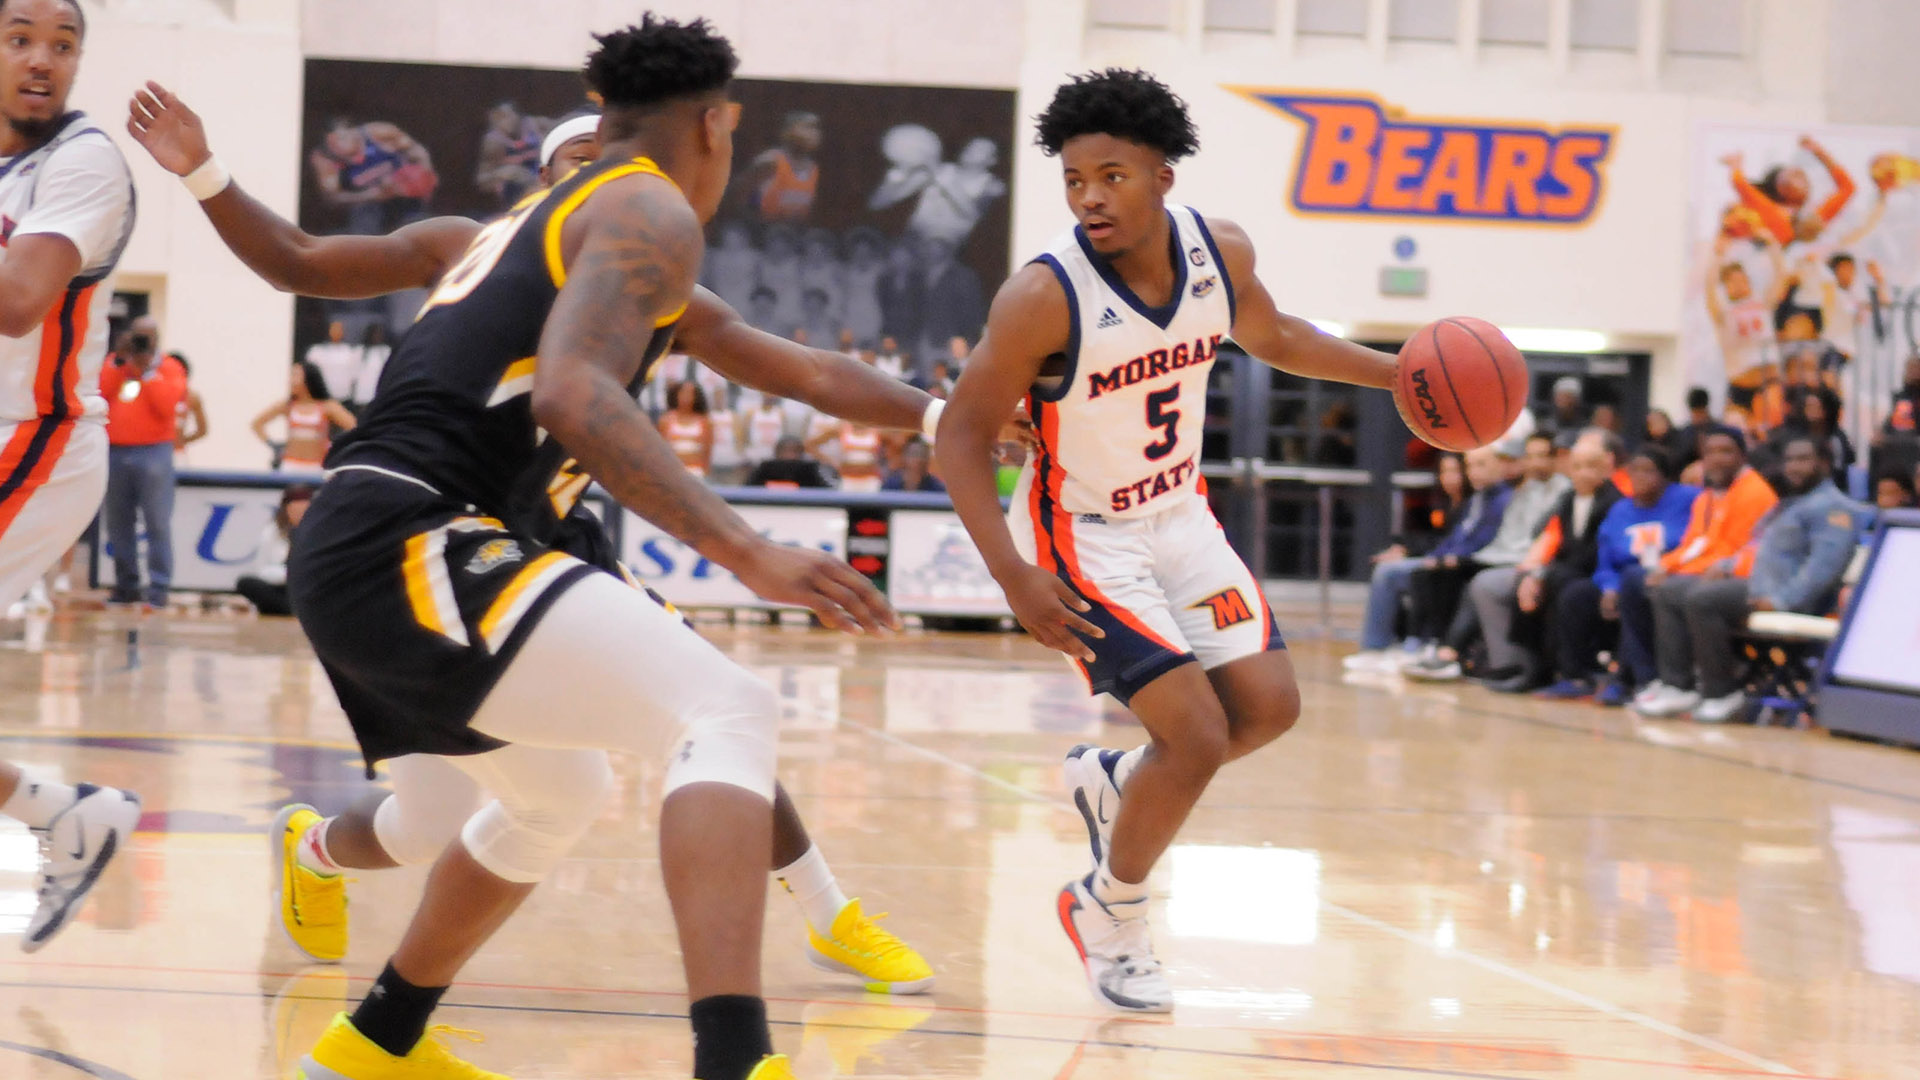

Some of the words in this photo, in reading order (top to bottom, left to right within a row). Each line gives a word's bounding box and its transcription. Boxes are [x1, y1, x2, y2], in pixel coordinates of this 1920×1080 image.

[1250, 90, 1616, 226] BEARS
[1143, 381, 1182, 463] 5
[1411, 368, 1449, 429] NCAA
